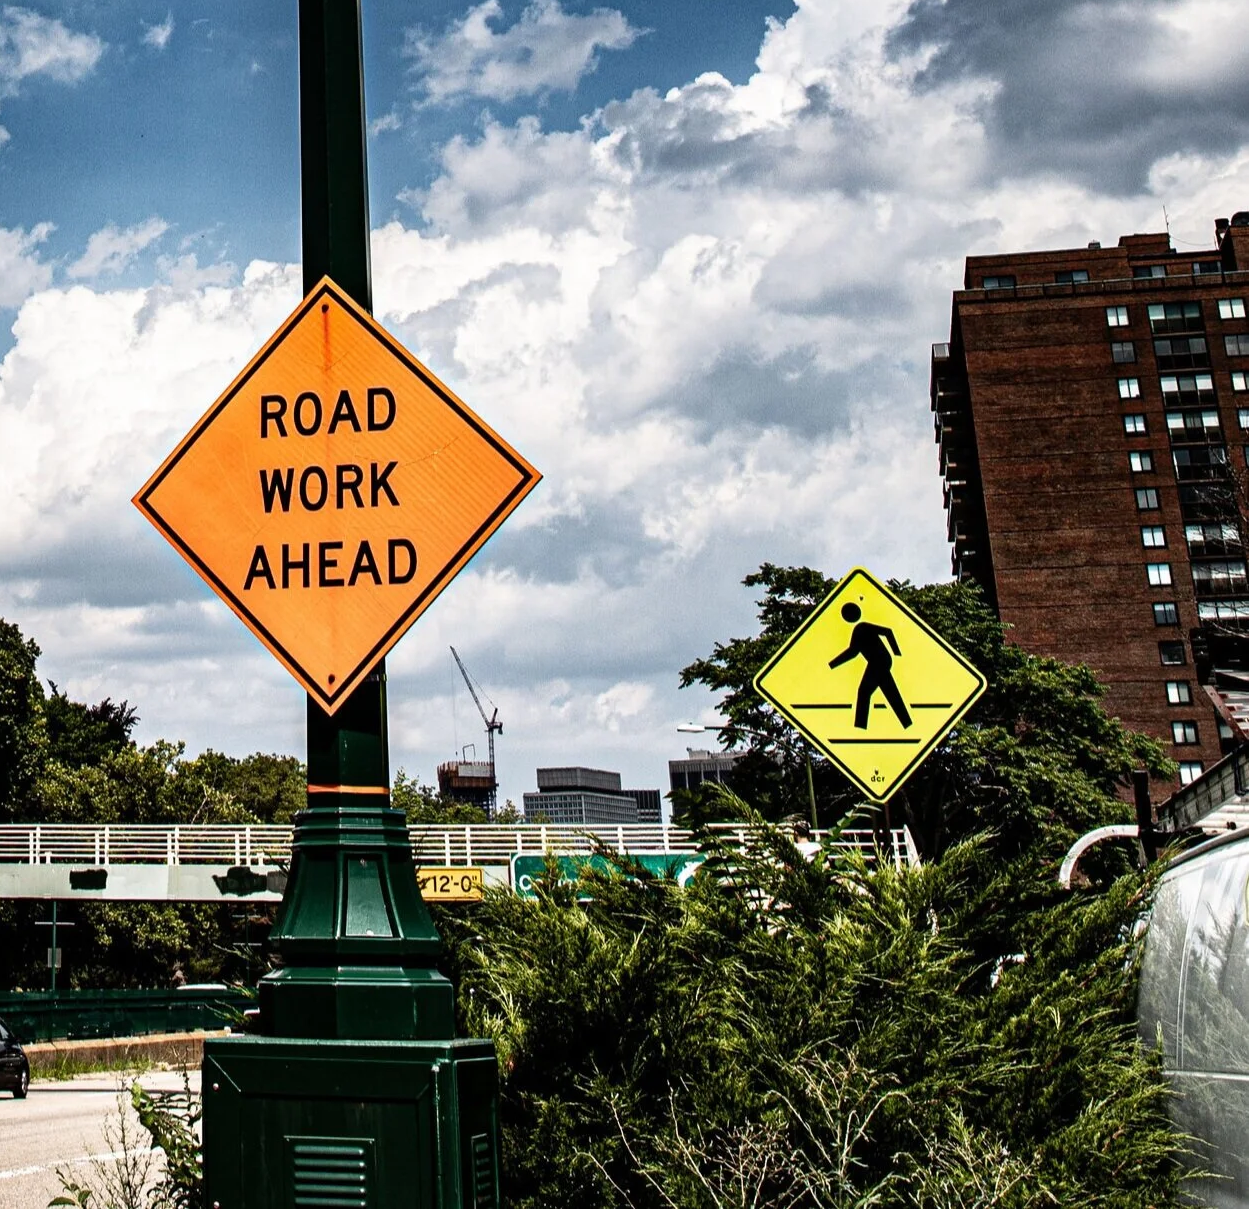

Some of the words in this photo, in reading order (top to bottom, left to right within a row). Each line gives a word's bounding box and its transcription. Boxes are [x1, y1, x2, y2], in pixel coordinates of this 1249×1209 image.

[260, 387, 397, 439] ROAD
[259, 462, 400, 513] WORK
[243, 538, 418, 590] AHEAD
